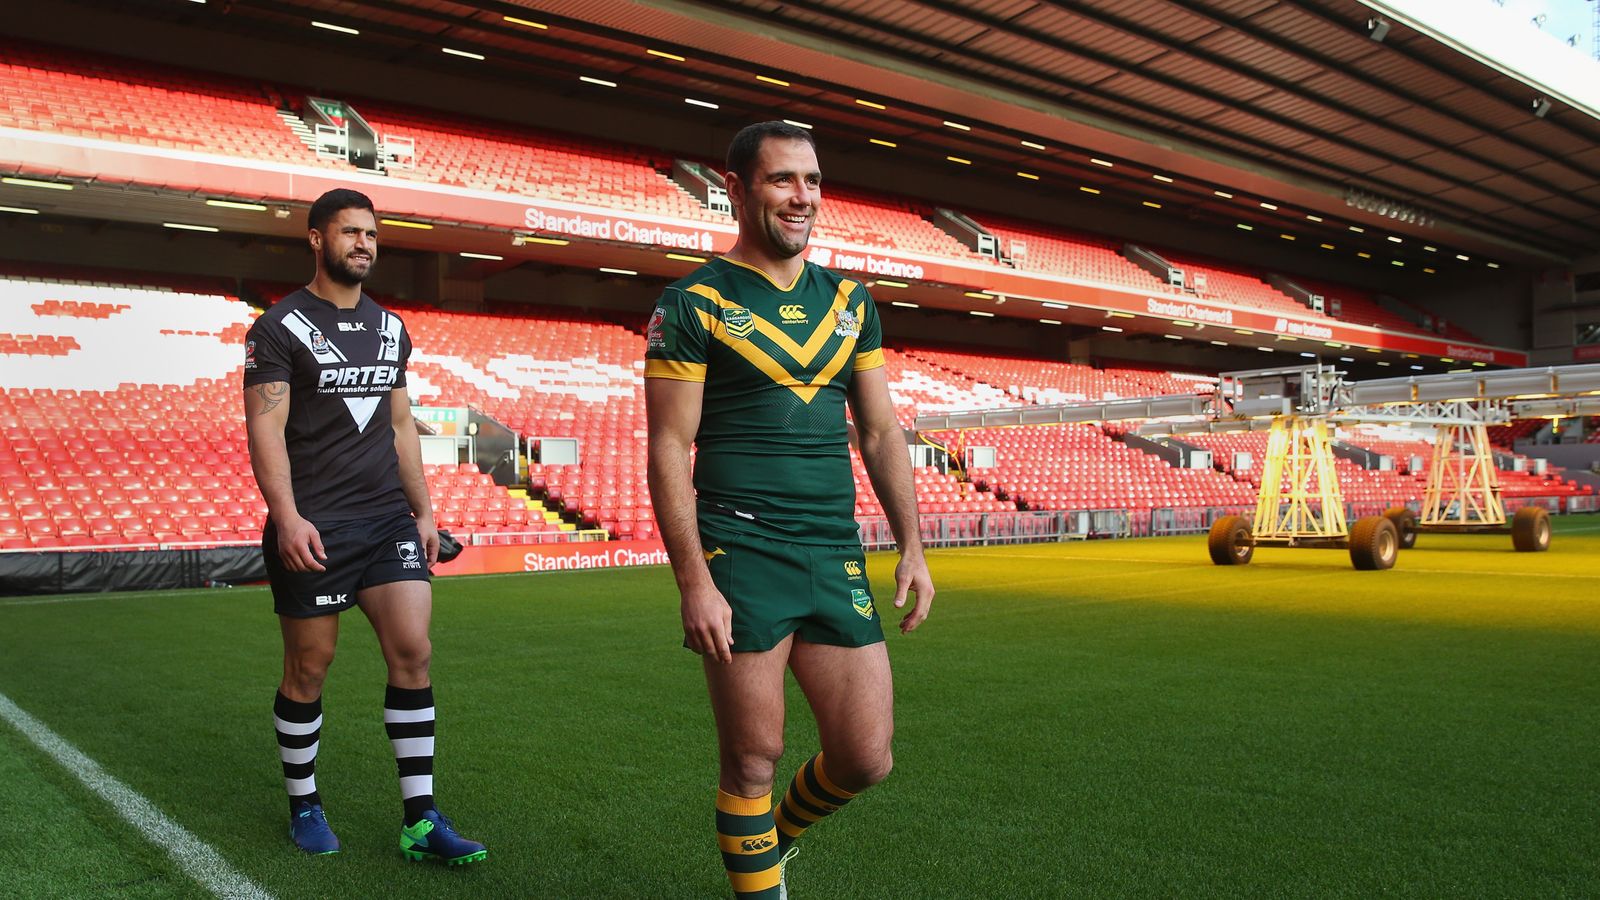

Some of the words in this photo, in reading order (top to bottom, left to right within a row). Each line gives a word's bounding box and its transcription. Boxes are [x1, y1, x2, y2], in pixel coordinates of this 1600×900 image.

[525, 208, 610, 239] Standard
[614, 220, 698, 249] Chartered
[835, 253, 865, 271] new
[867, 255, 924, 279] balance
[1147, 298, 1186, 318] Standard
[1186, 304, 1226, 323] Chartered
[337, 322, 368, 332] BLK
[318, 366, 399, 388] PIRTEK
[337, 385, 369, 393] transfer
[524, 550, 610, 572] Standard
[315, 593, 348, 606] BLK
